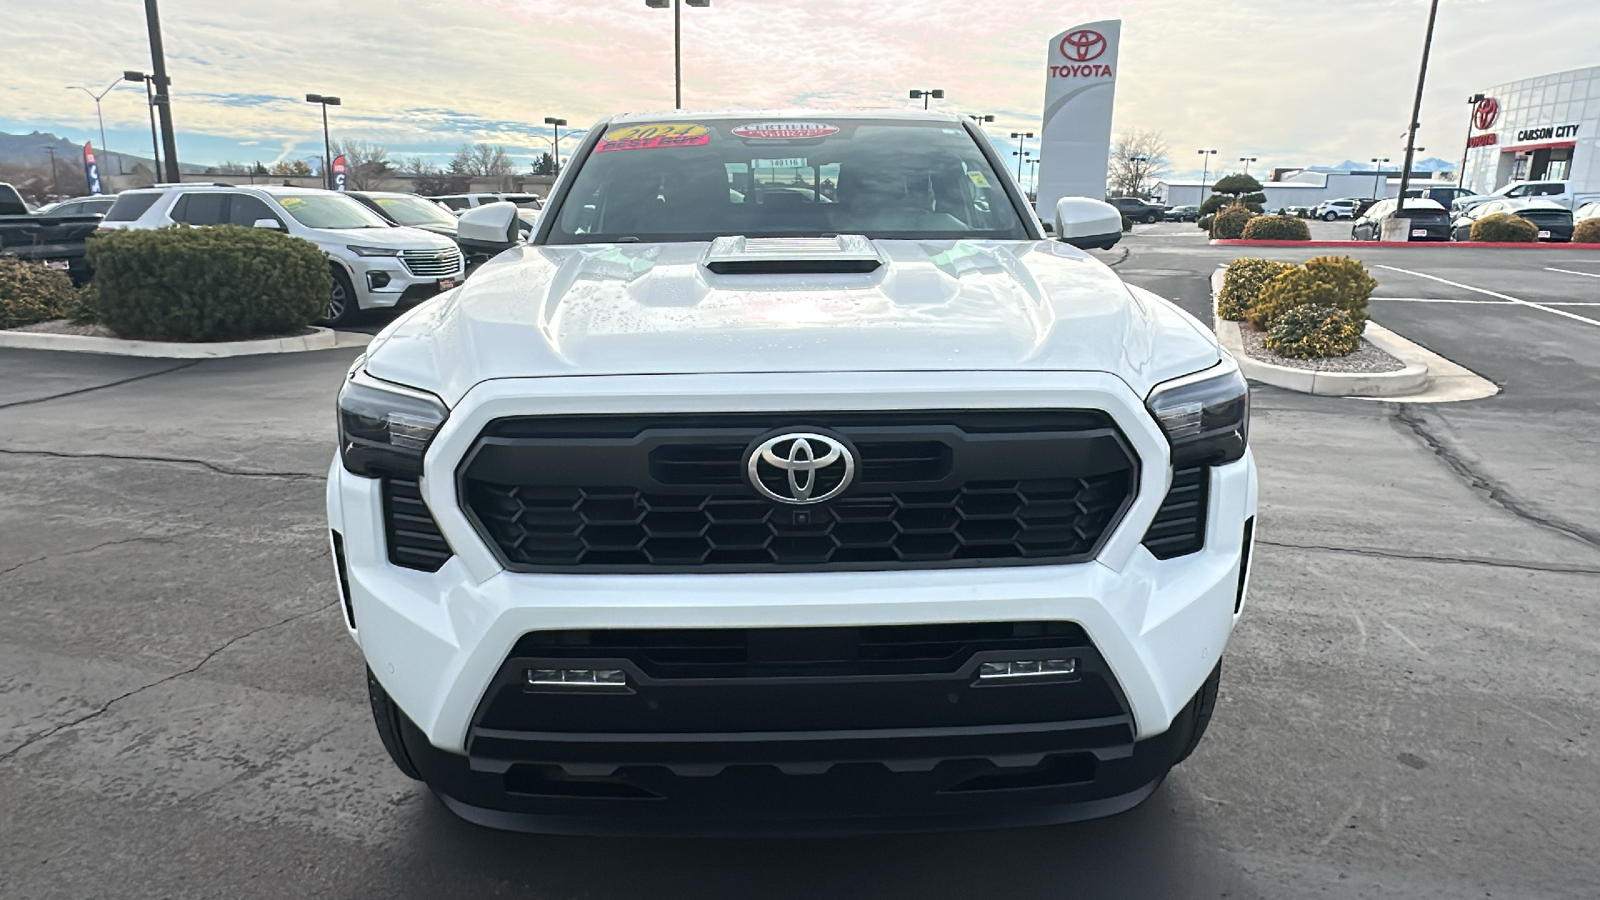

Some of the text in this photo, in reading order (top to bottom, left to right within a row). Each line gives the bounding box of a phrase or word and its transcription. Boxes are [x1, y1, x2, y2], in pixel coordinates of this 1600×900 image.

[1050, 65, 1112, 78] TOYOTA
[626, 125, 697, 139] 2024
[1518, 124, 1579, 141] CARSON CITY
[603, 136, 702, 149] BEST BUY
